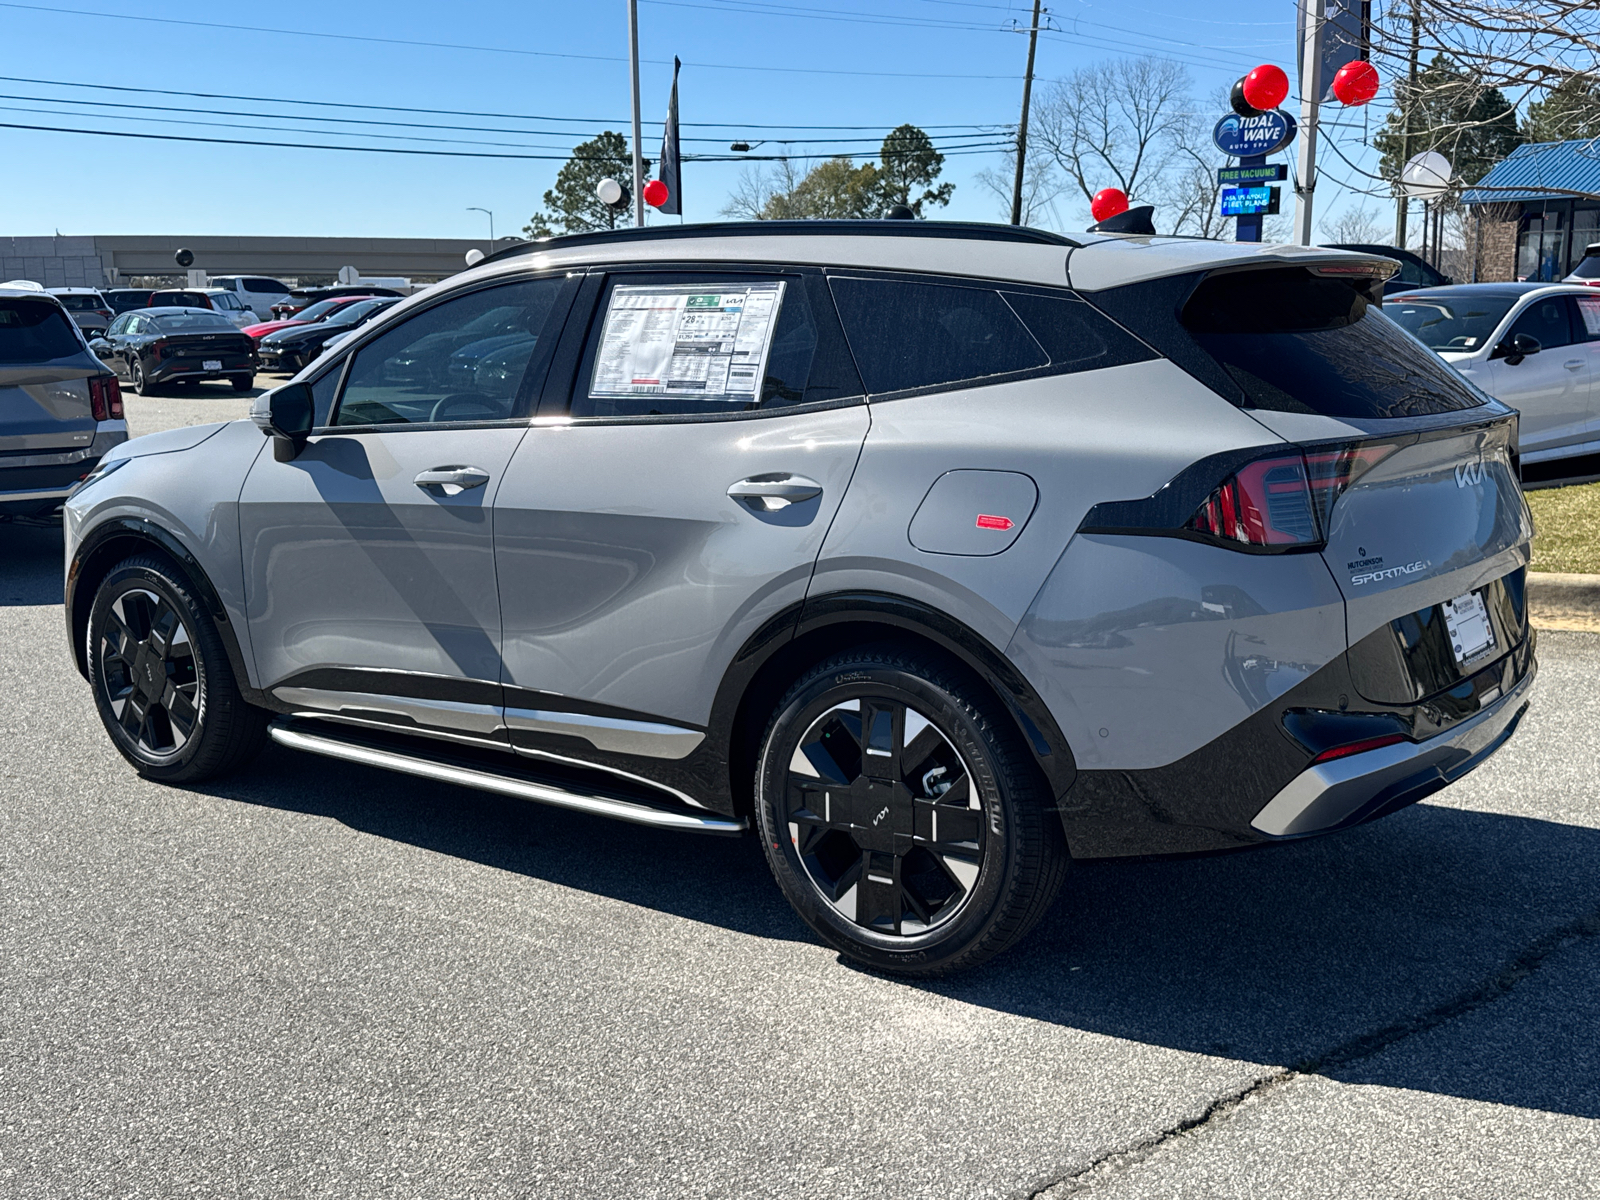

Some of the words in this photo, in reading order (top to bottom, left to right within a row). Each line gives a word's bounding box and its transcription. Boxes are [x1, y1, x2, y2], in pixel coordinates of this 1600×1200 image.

[1239, 114, 1273, 129] TIDAL
[1243, 127, 1281, 142] WAVE
[1220, 171, 1239, 180] FREE
[1240, 168, 1276, 178] VACUUMS
[685, 315, 696, 324] 28
[1453, 460, 1488, 488] KIA
[1347, 557, 1384, 569] HUTCHINSON
[1351, 560, 1424, 586] SPORTAGE
